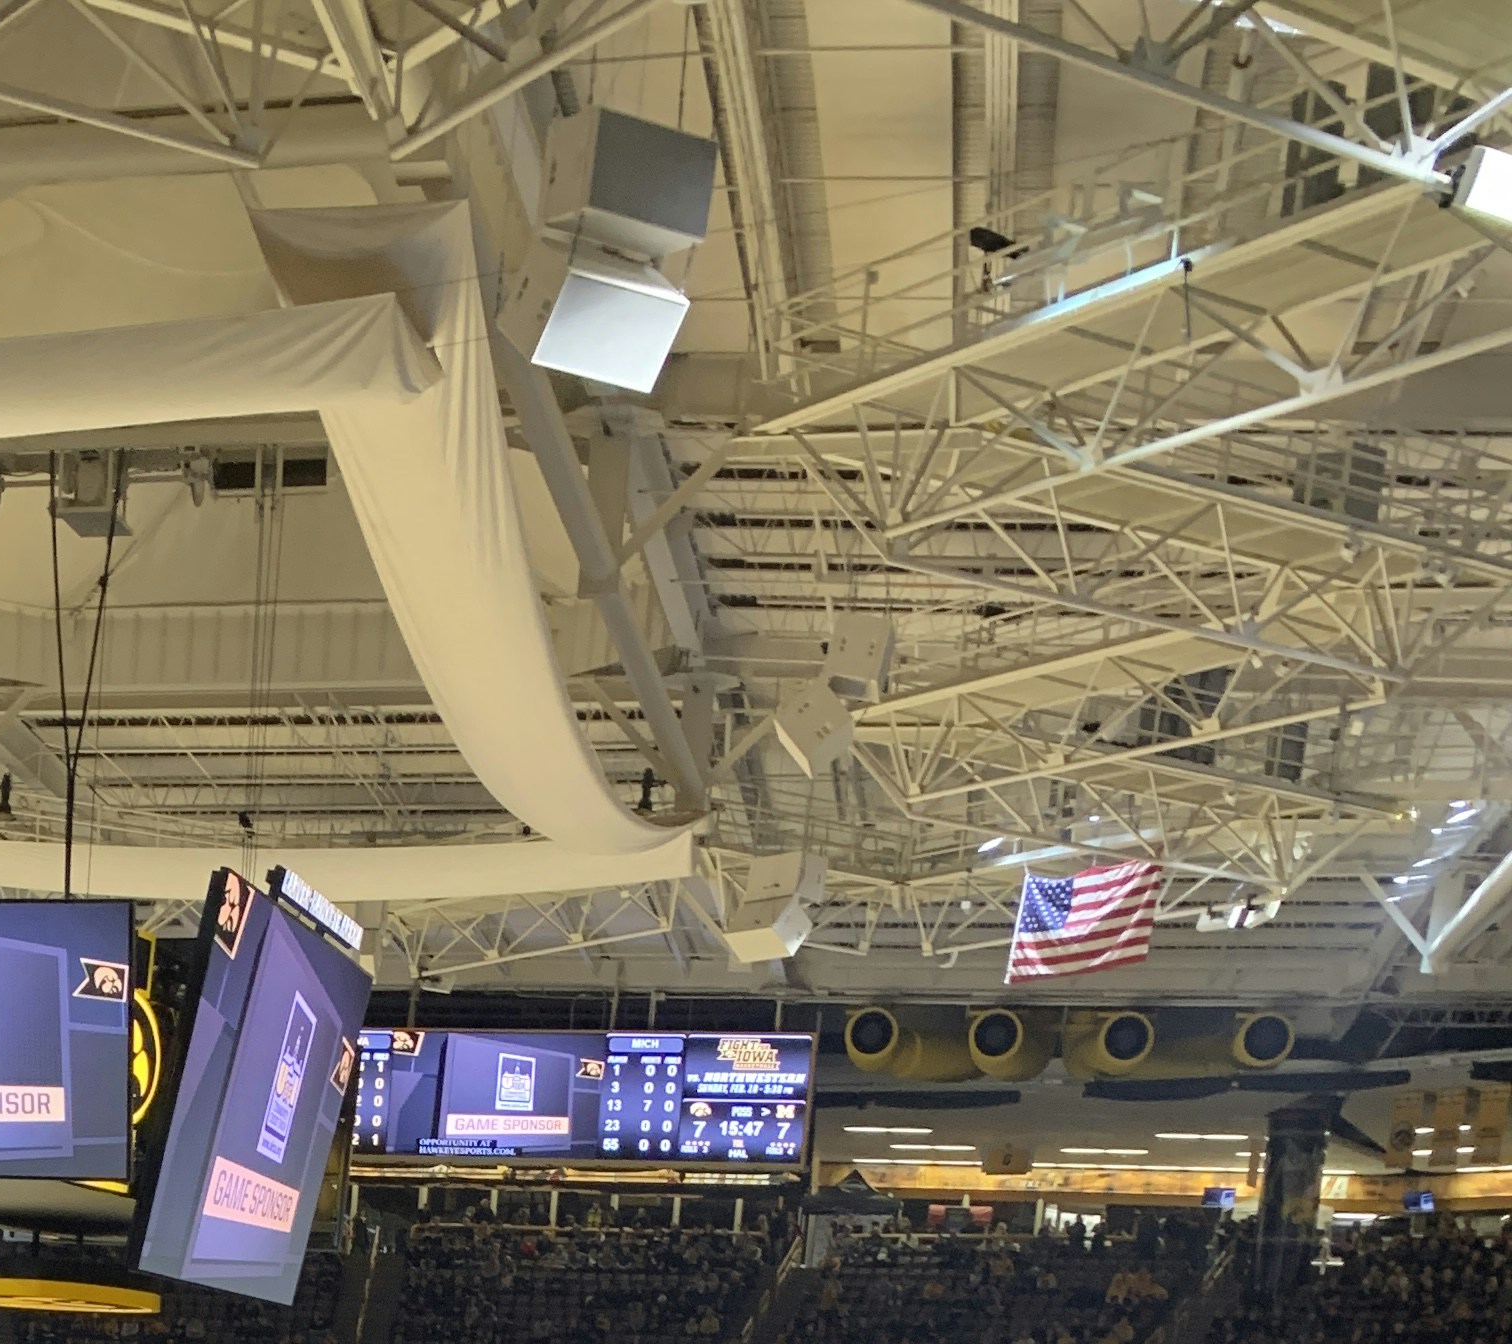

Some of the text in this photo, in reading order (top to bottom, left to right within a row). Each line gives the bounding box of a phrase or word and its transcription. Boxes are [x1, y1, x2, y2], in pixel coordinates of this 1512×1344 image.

[631, 1038, 659, 1049] MICH
[720, 1039, 759, 1050] FIGHT
[736, 1049, 775, 1062] IOWA
[377, 1061, 384, 1072] 1
[613, 1064, 678, 1077] 1 0 0
[375, 1077, 385, 1089] 0
[703, 1071, 806, 1084] NORTHWESTERN
[611, 1081, 676, 1094] 3 0 0
[374, 1094, 383, 1107] 0
[607, 1099, 674, 1112] 13 7 0
[372, 1114, 382, 1127] 0
[455, 1118, 561, 1131] GAME SPONSOR
[604, 1119, 672, 1132] 23 0 0
[693, 1120, 791, 1140] 7 15:47 7
[351, 1133, 379, 1146] 2 1
[419, 1138, 492, 1147] OPPORTUNITY AT
[603, 1138, 670, 1151] 55 0 0
[213, 1169, 294, 1224] GAME SPONSOR
